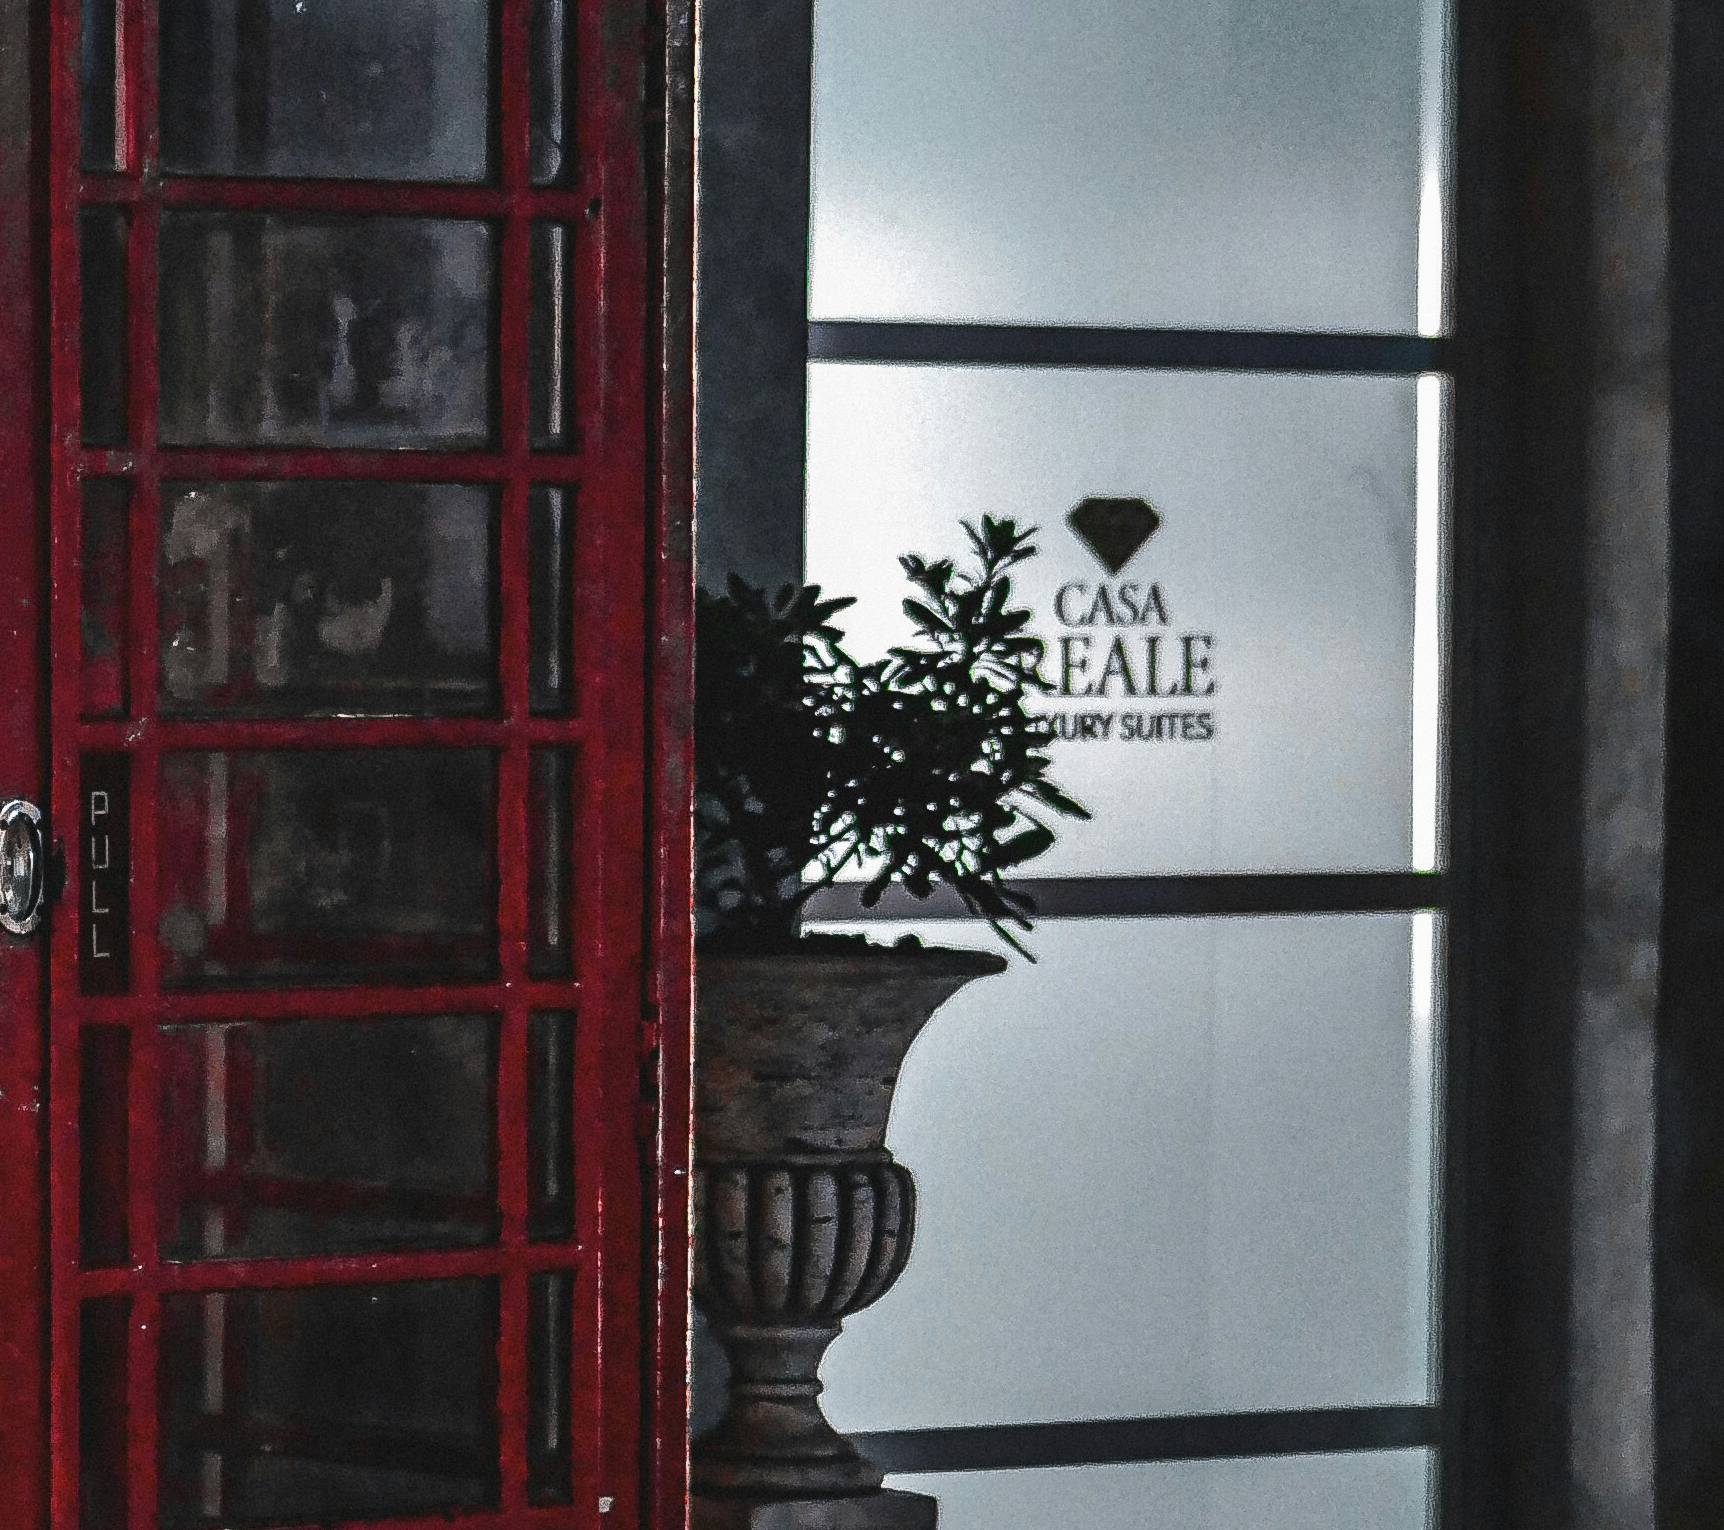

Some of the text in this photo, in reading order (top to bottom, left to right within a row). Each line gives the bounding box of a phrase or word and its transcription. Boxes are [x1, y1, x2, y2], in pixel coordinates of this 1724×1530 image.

[1053, 580, 1169, 627] CASA
[1120, 711, 1215, 742] SUITES
[90, 790, 110, 957] PULL
